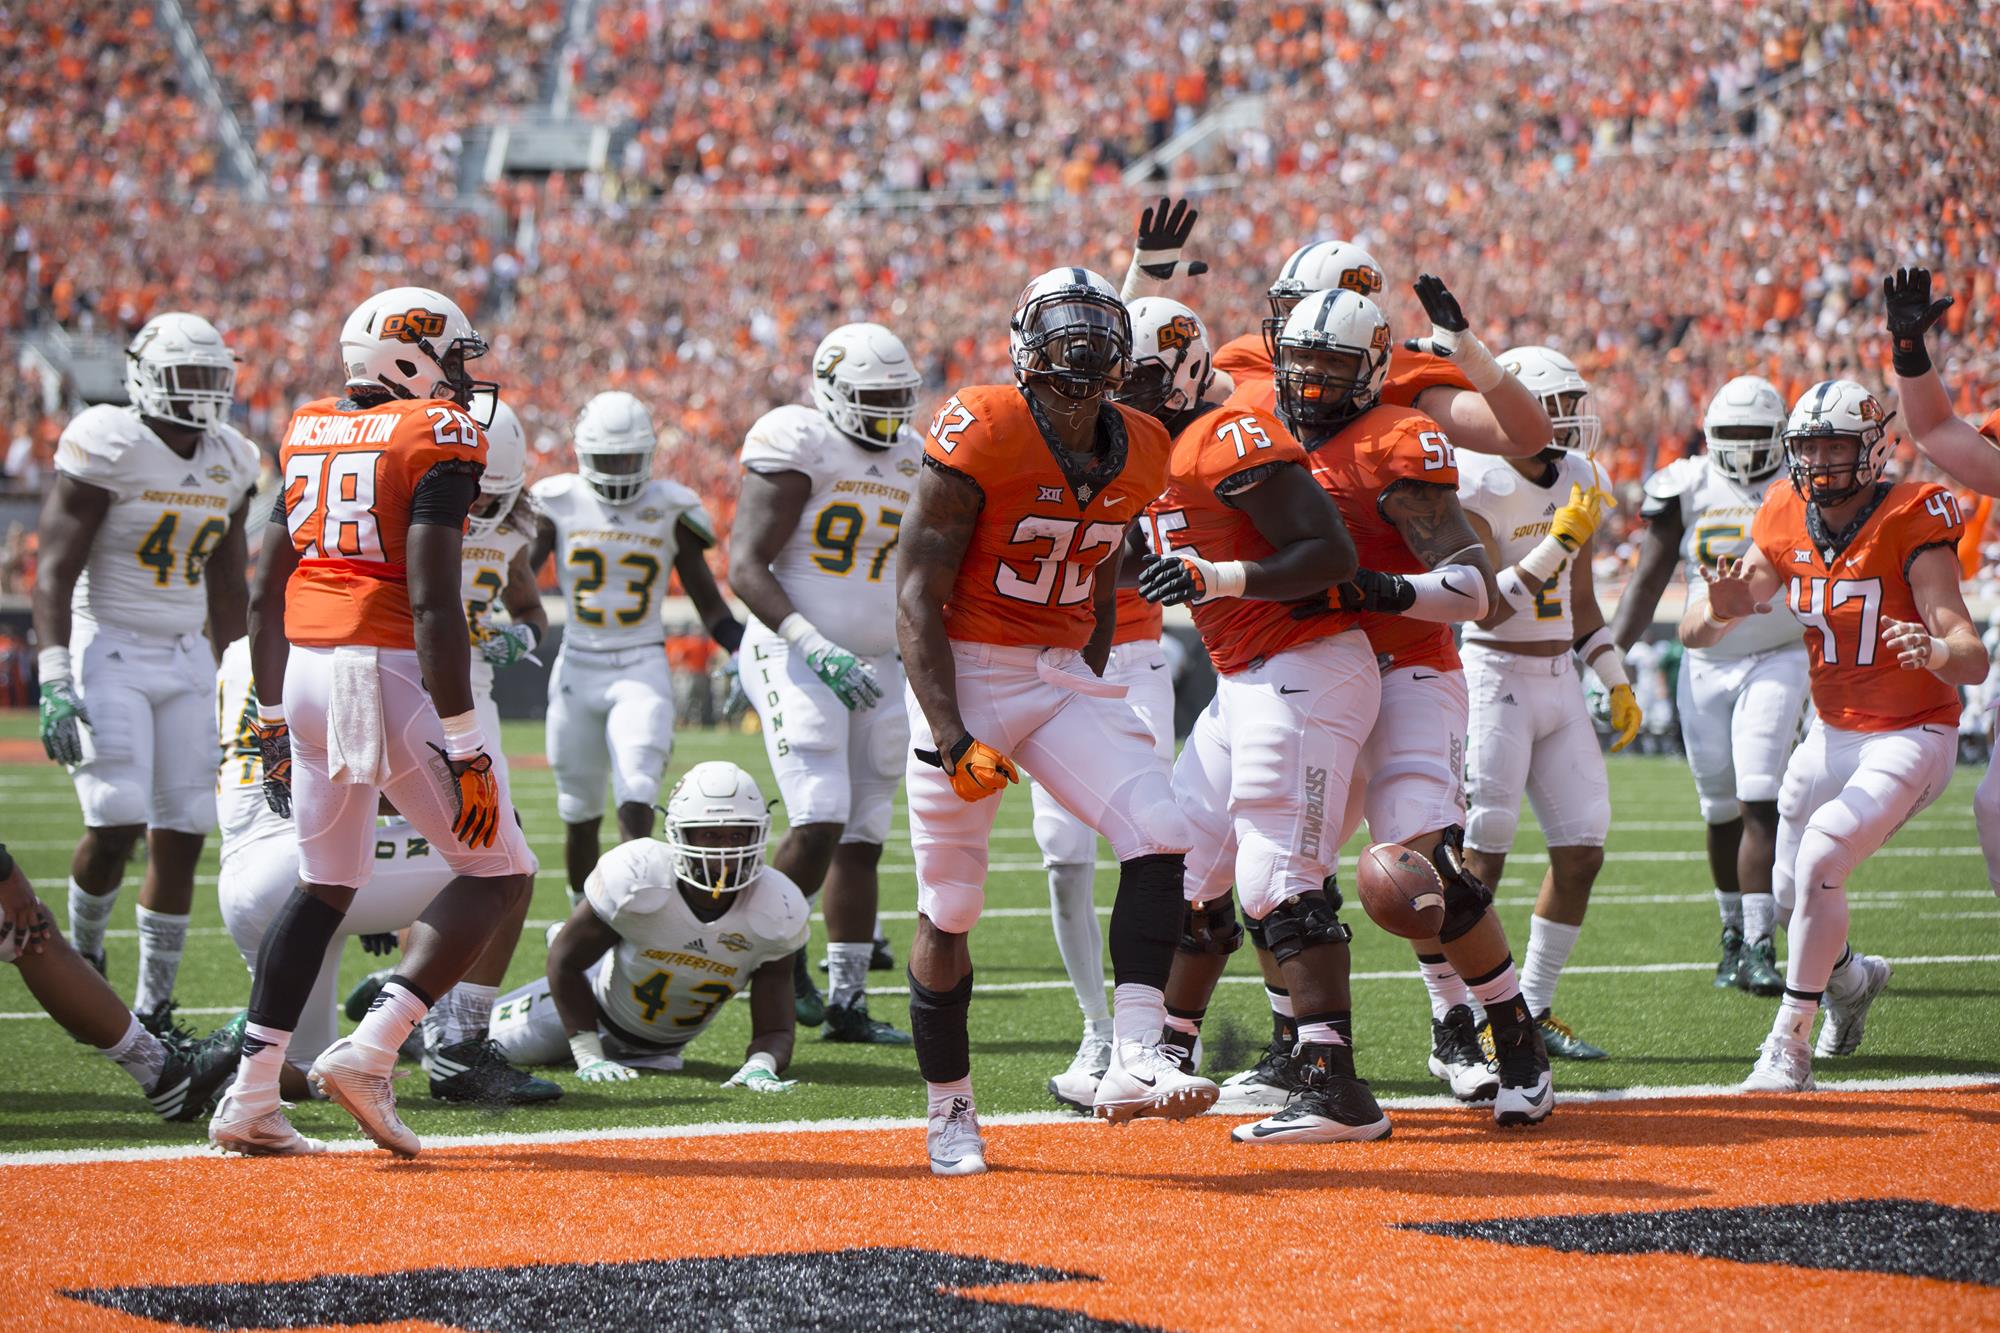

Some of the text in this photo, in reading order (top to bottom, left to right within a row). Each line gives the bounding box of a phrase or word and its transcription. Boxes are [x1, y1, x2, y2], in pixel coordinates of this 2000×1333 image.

[379, 307, 448, 344] OSU
[1157, 315, 1201, 352] OSU
[288, 414, 401, 446] WASHINGTON
[425, 407, 479, 448] 28
[930, 396, 976, 455] 32
[1216, 416, 1273, 458] 75
[285, 450, 388, 563] 28
[1925, 491, 1961, 529] 47
[810, 500, 903, 583] 97
[993, 513, 1127, 606] 32
[568, 546, 662, 629] 23
[1790, 576, 1883, 667] 47
[753, 645, 790, 758] LIONS
[1300, 766, 1327, 860] COWBOYS
[631, 968, 737, 1028] 43
